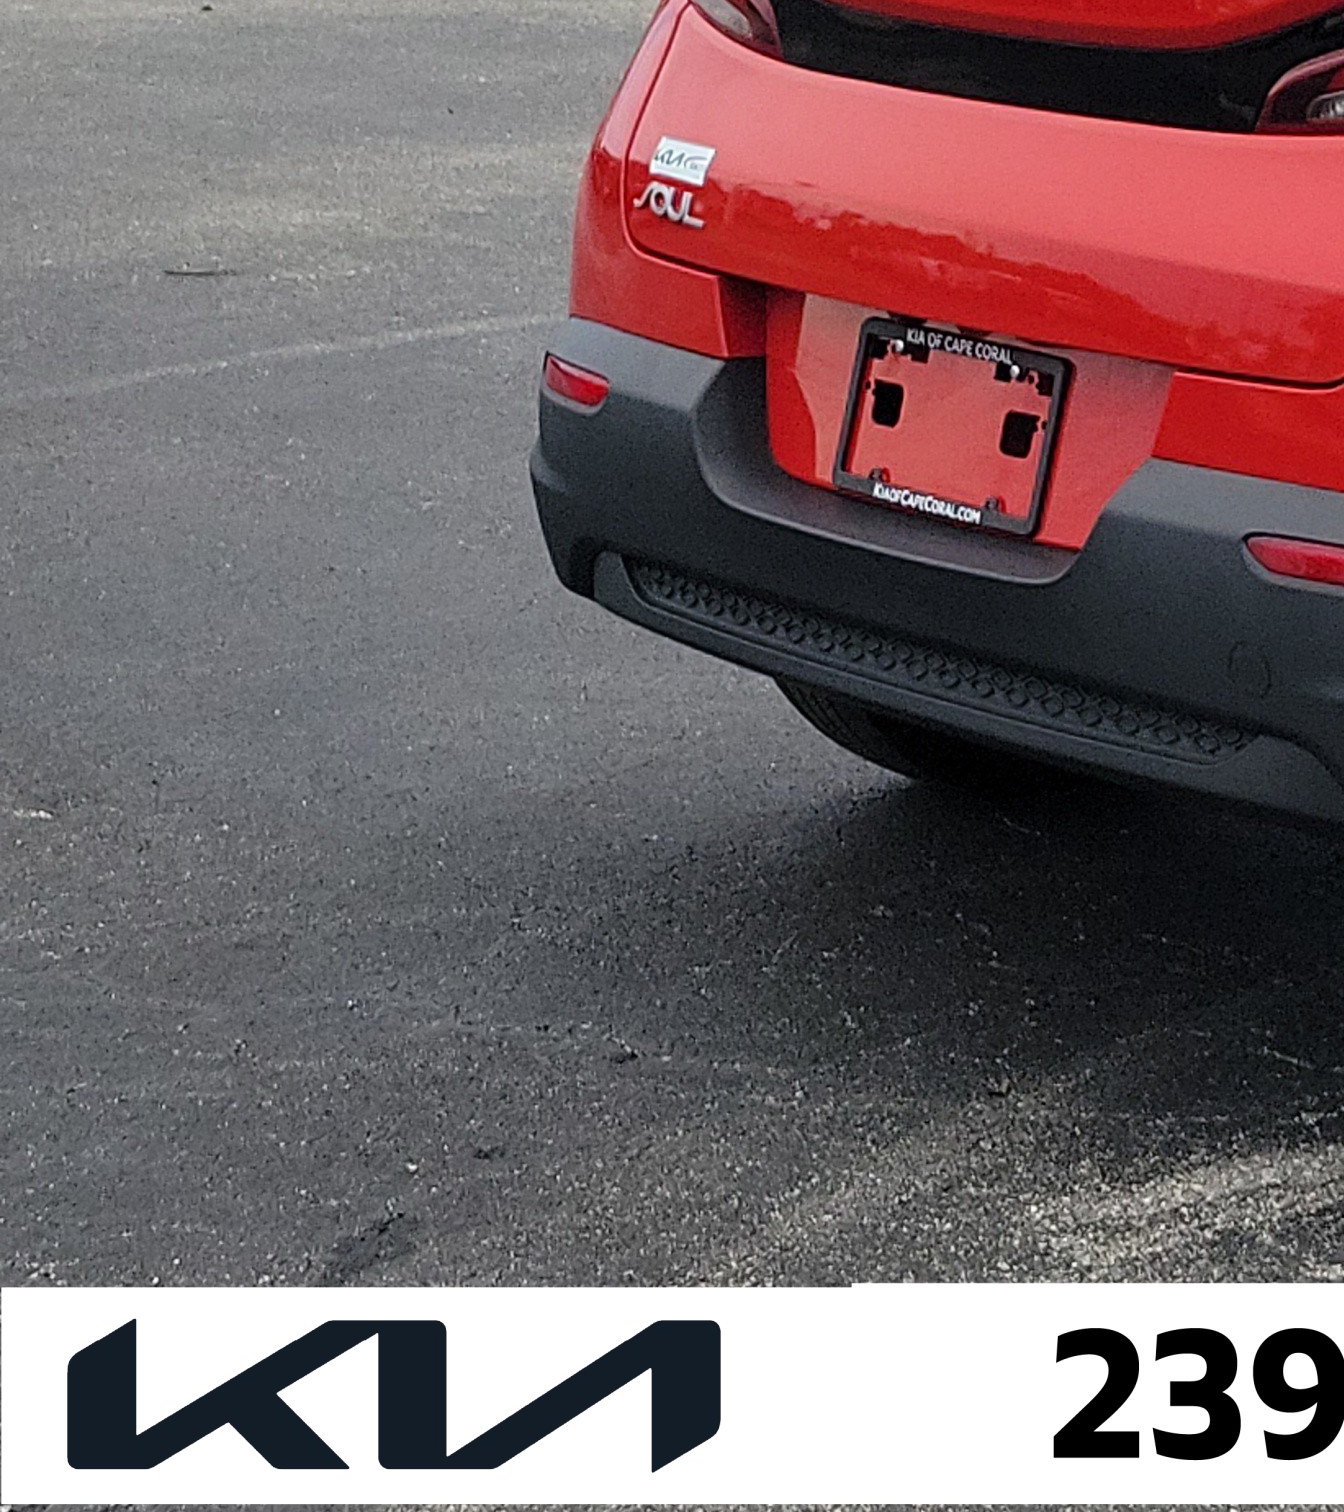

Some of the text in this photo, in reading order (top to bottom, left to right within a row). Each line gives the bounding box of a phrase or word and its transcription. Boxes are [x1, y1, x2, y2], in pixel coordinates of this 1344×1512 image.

[906, 328, 1013, 366] KIA OF CAPE CORAL
